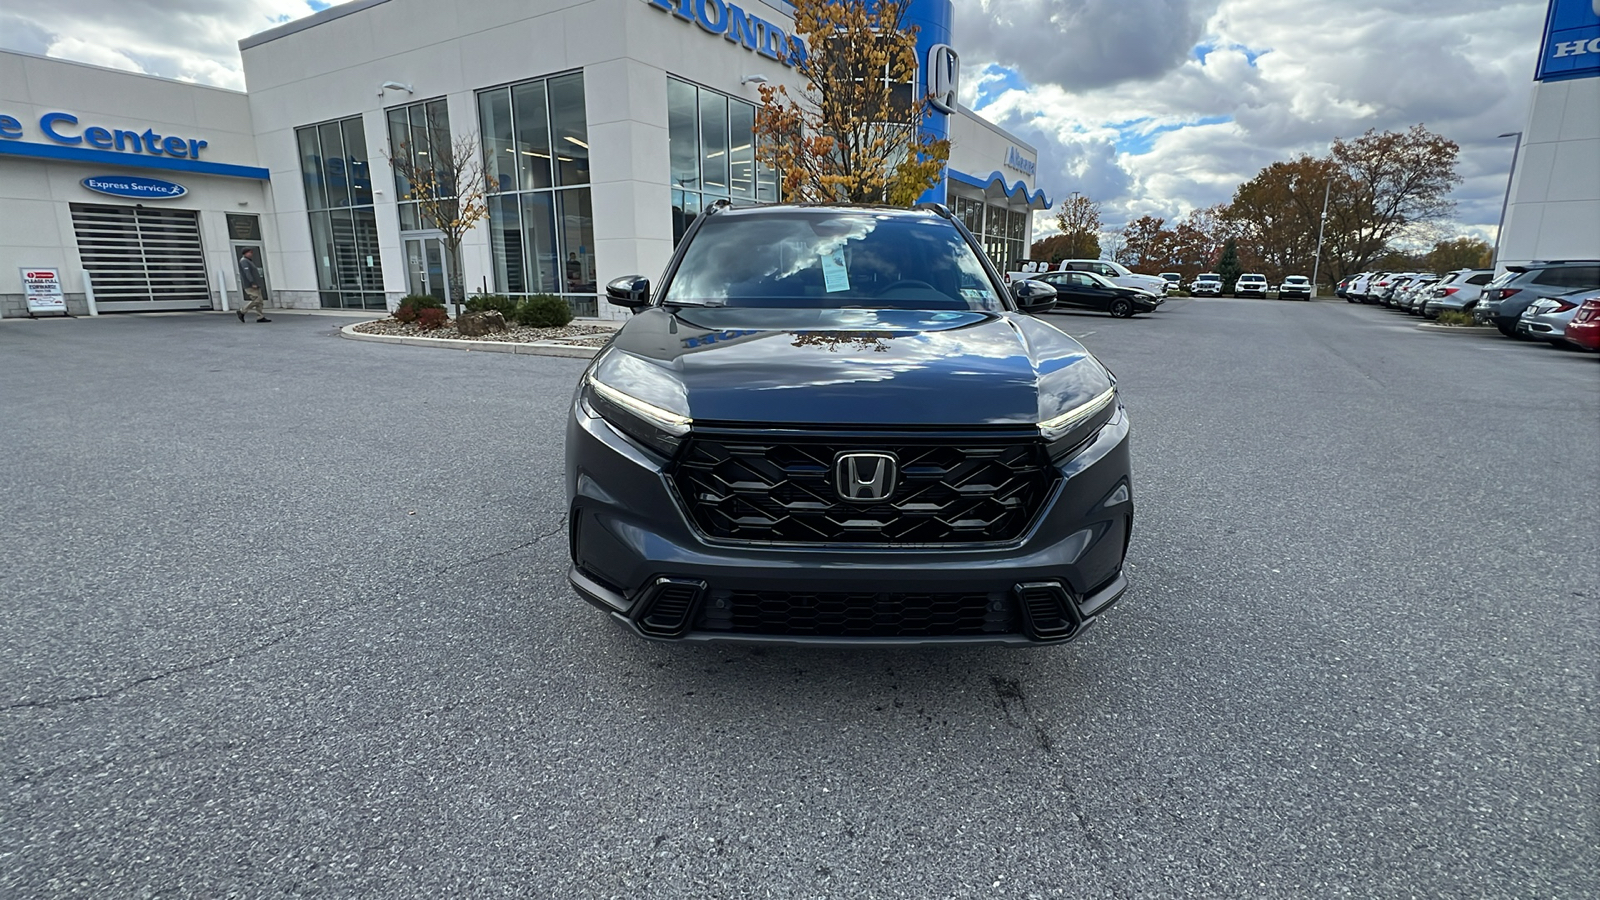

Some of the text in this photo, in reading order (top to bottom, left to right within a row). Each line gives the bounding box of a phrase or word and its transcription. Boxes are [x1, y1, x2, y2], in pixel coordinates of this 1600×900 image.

[39, 112, 208, 159] Center
[88, 179, 167, 193] Express Service
